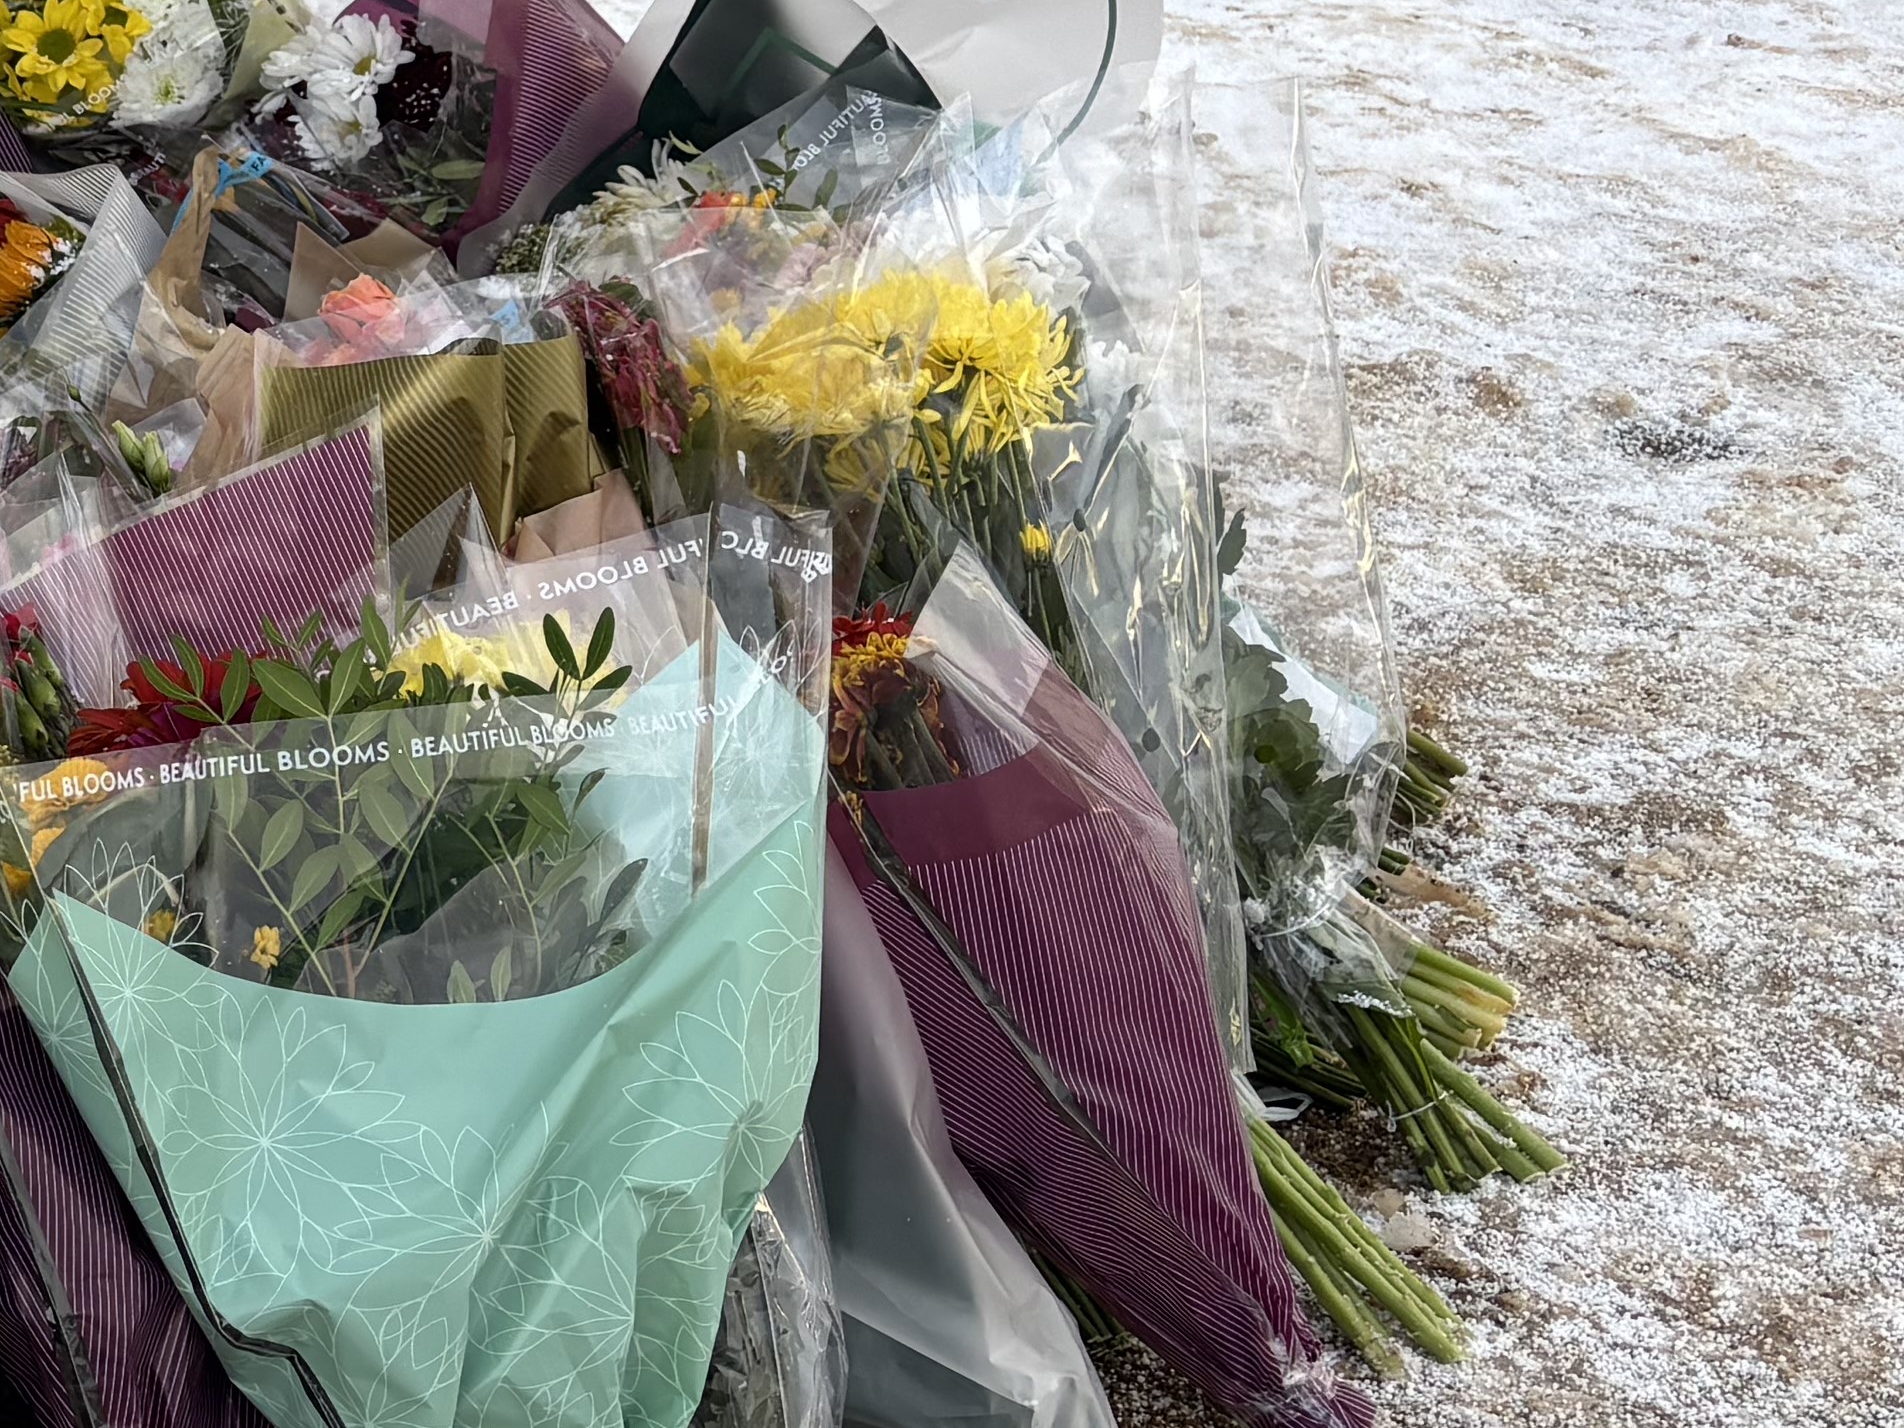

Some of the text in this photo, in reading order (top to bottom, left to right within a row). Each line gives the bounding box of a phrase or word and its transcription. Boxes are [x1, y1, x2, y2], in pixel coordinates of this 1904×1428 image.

[62, 765, 145, 798] BLOOMS
[159, 752, 271, 785] BEAUTIFUL
[277, 741, 391, 773] BLOOMS
[410, 726, 531, 760] BEAUTIFUL
[531, 717, 616, 748] BLOOMS
